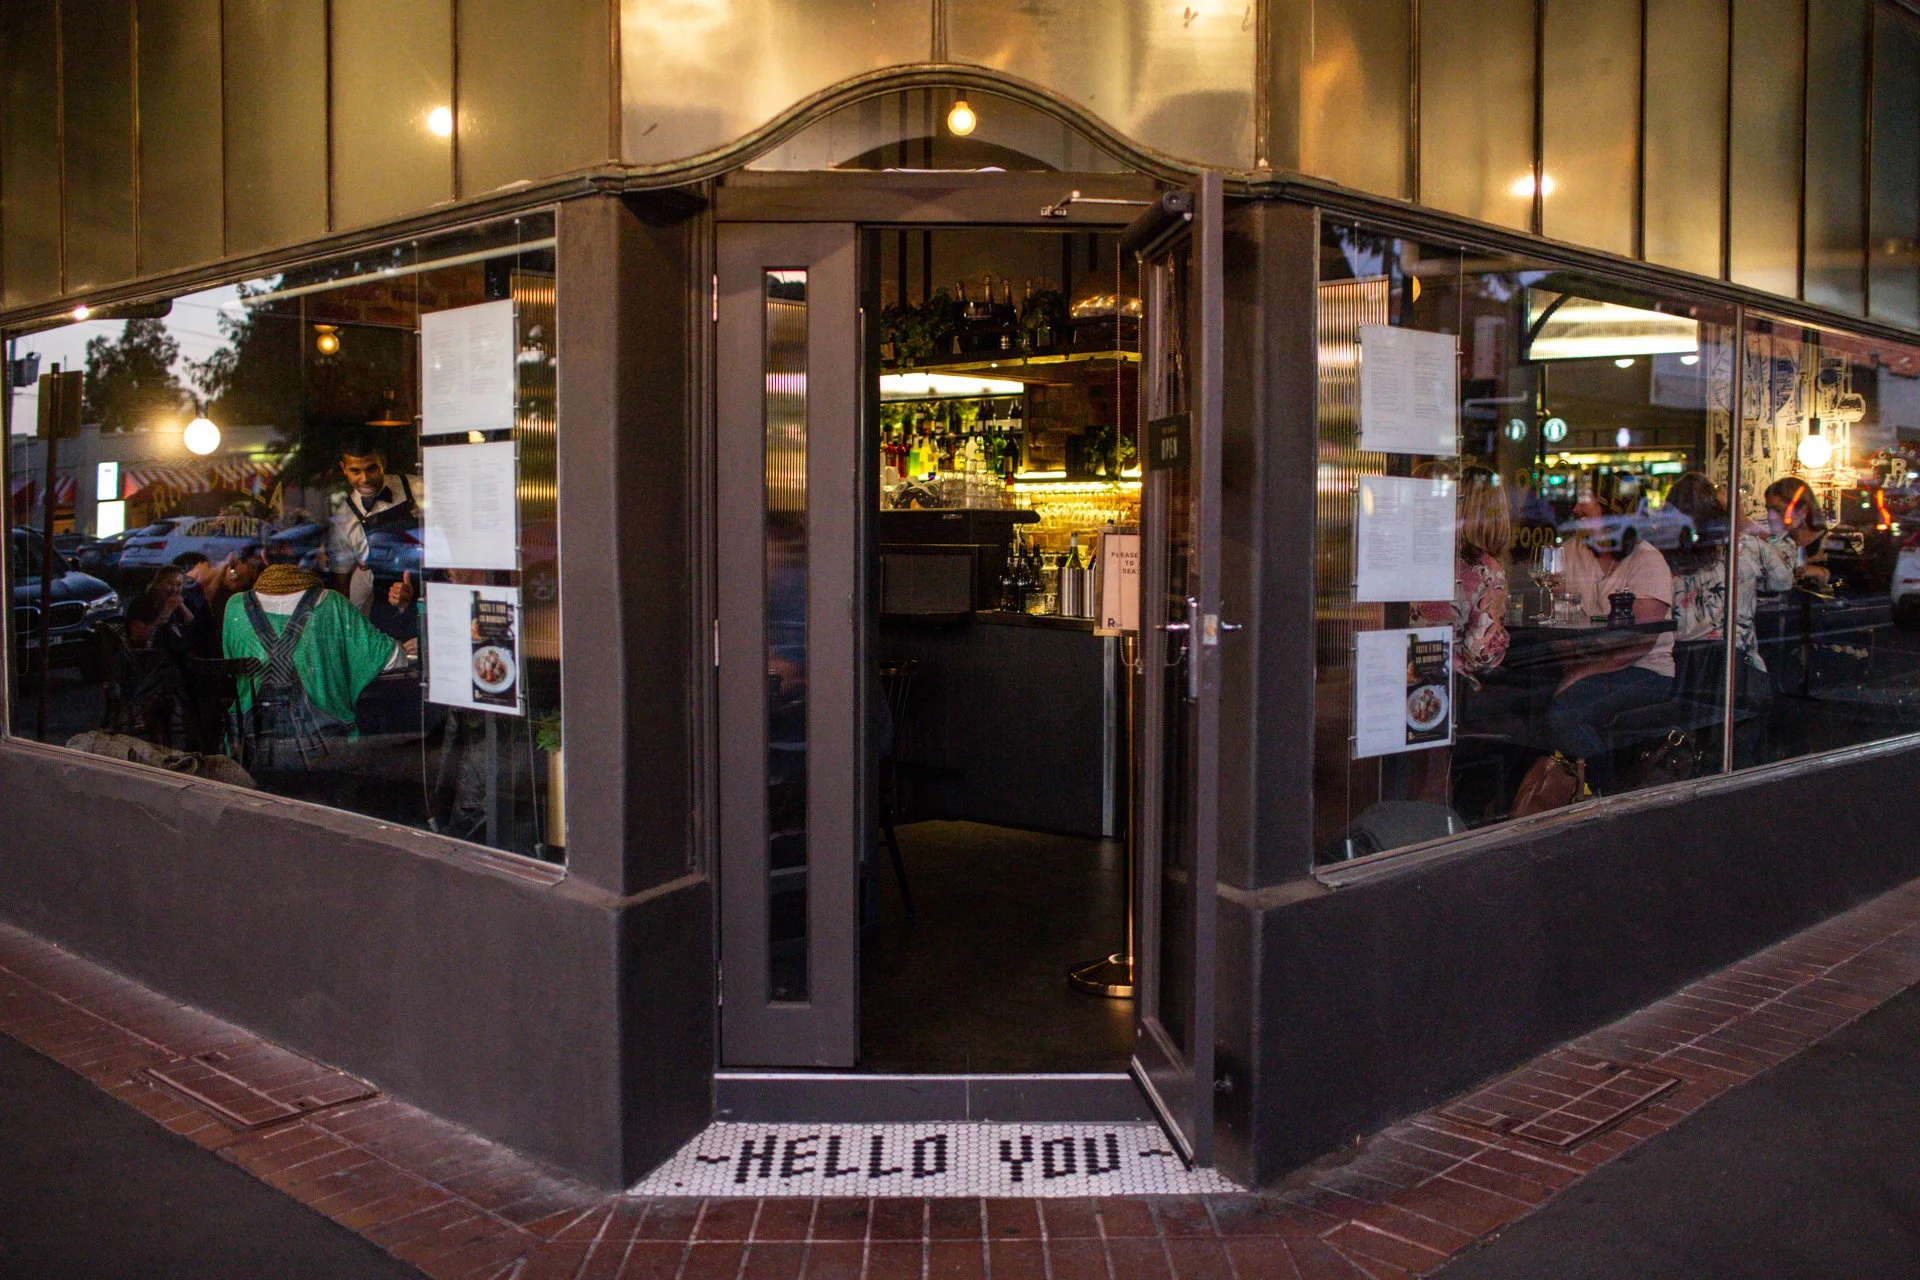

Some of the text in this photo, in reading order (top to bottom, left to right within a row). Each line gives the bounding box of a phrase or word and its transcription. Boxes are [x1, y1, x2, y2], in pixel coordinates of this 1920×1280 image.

[224, 517, 259, 538] WINE
[1111, 551, 1139, 559] PLEASE
[734, 1133, 1121, 1184] HELLO YOU
